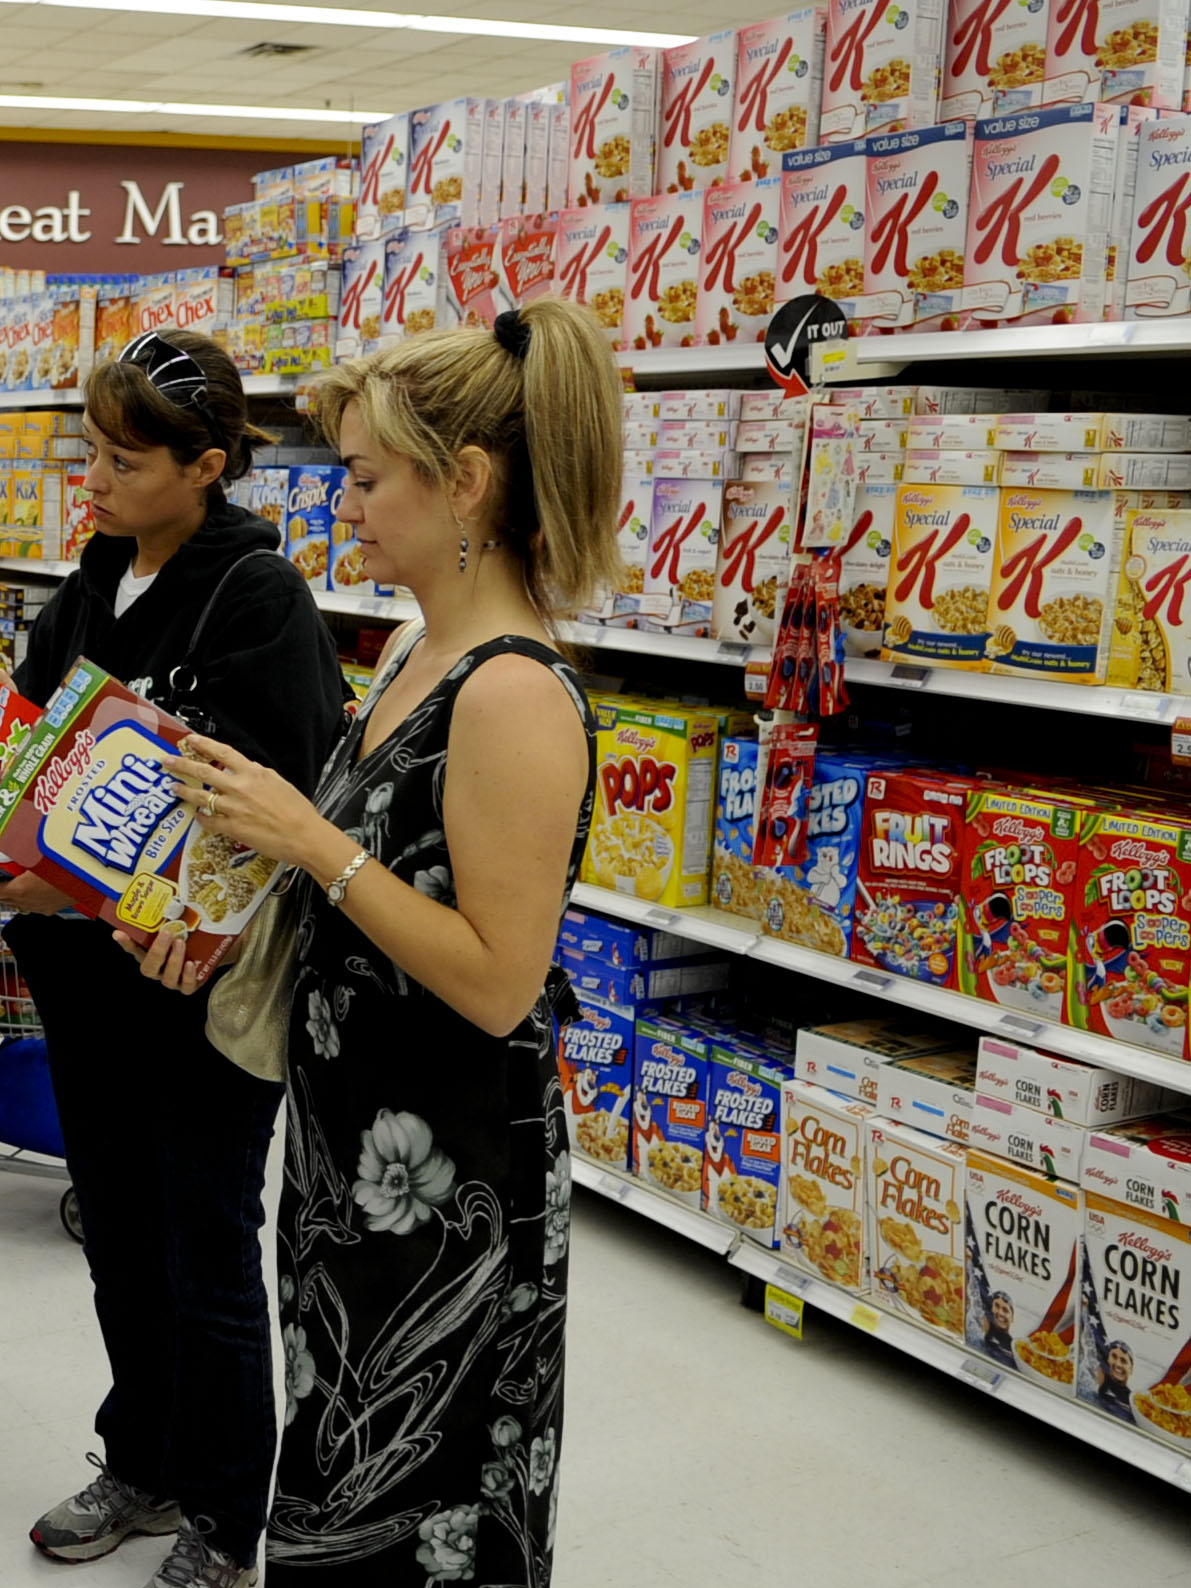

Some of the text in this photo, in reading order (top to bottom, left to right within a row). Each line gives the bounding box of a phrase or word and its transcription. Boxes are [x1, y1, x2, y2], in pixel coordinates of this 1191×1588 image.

[746, 38, 778, 61] Special
[668, 59, 702, 82] Special
[576, 74, 603, 95] Special
[982, 114, 1040, 136] value size
[1148, 127, 1185, 143] Kellogg's
[872, 132, 920, 153] value size
[787, 148, 832, 169] value size
[984, 155, 1036, 181] Special
[875, 171, 918, 194] Special
[791, 185, 829, 208] Special
[114, 180, 225, 245] Ma
[710, 203, 746, 226] Special
[565, 225, 598, 244] Special
[637, 216, 670, 238] Special
[141, 300, 174, 333] Chex
[176, 296, 215, 329] Chex
[807, 320, 846, 340] IT OUT
[288, 481, 331, 513] Crispix
[657, 500, 692, 516] Special
[902, 492, 934, 506] Kellogg's
[1007, 494, 1043, 511] Kellogg's
[728, 501, 768, 520] Special
[903, 509, 951, 529] Special
[1008, 512, 1061, 533] Special
[617, 728, 657, 753] Kellogg's
[690, 732, 716, 754] POPS
[18, 755, 39, 784] WHOLE
[34, 730, 96, 815] Kellogg's
[66, 759, 107, 812] FROSTED
[599, 756, 678, 817] POPS
[985, 795, 1051, 819] LIMITED EDITION
[145, 808, 185, 860] Bite Size
[875, 811, 949, 845] FRUIT
[994, 816, 1045, 844] Kellogg's
[1103, 816, 1178, 842] LIMITED EDITION
[873, 838, 953, 873] RINGS
[985, 844, 1045, 871] FROOT
[1111, 838, 1170, 867] Kellogg's
[994, 863, 1051, 887] LOOPS
[1099, 868, 1169, 897] FROOT
[125, 889, 137, 912] Maple
[1111, 889, 1177, 914] LOOPS
[563, 1027, 623, 1050] FROSTED
[565, 1043, 614, 1065] FLAKES
[641, 1060, 697, 1085] FROSTED
[978, 1070, 1009, 1087] Kellogg's
[642, 1074, 689, 1097] FLAKES
[1015, 1079, 1041, 1096] CORN
[1109, 1080, 1119, 1111] FLAKES
[714, 1088, 774, 1115] FROSTED
[1015, 1092, 1041, 1109] FLAKES
[1100, 1083, 1111, 1113] CORN
[715, 1105, 765, 1130] FLAKES
[800, 1115, 848, 1159] Corn
[971, 1123, 1001, 1142] Kellogg's
[1008, 1134, 1033, 1151] CORN
[791, 1139, 853, 1192] Flakes
[1008, 1146, 1034, 1164] FLAKES
[889, 1154, 941, 1202] Corn
[969, 1170, 984, 1183] USA
[1085, 1166, 1119, 1186] Kellogg's
[1126, 1177, 1155, 1198] CORN
[881, 1180, 951, 1236] Flakes
[997, 1189, 1043, 1217] Kellogg's
[1125, 1191, 1155, 1210] FLAKES
[985, 1200, 1050, 1253] CORN
[1088, 1211, 1105, 1225] USA
[985, 1231, 1051, 1281] FLAKES
[1118, 1231, 1173, 1262] Kellogg's
[1104, 1244, 1181, 1300] CORN
[1103, 1276, 1181, 1331] FLAKES
